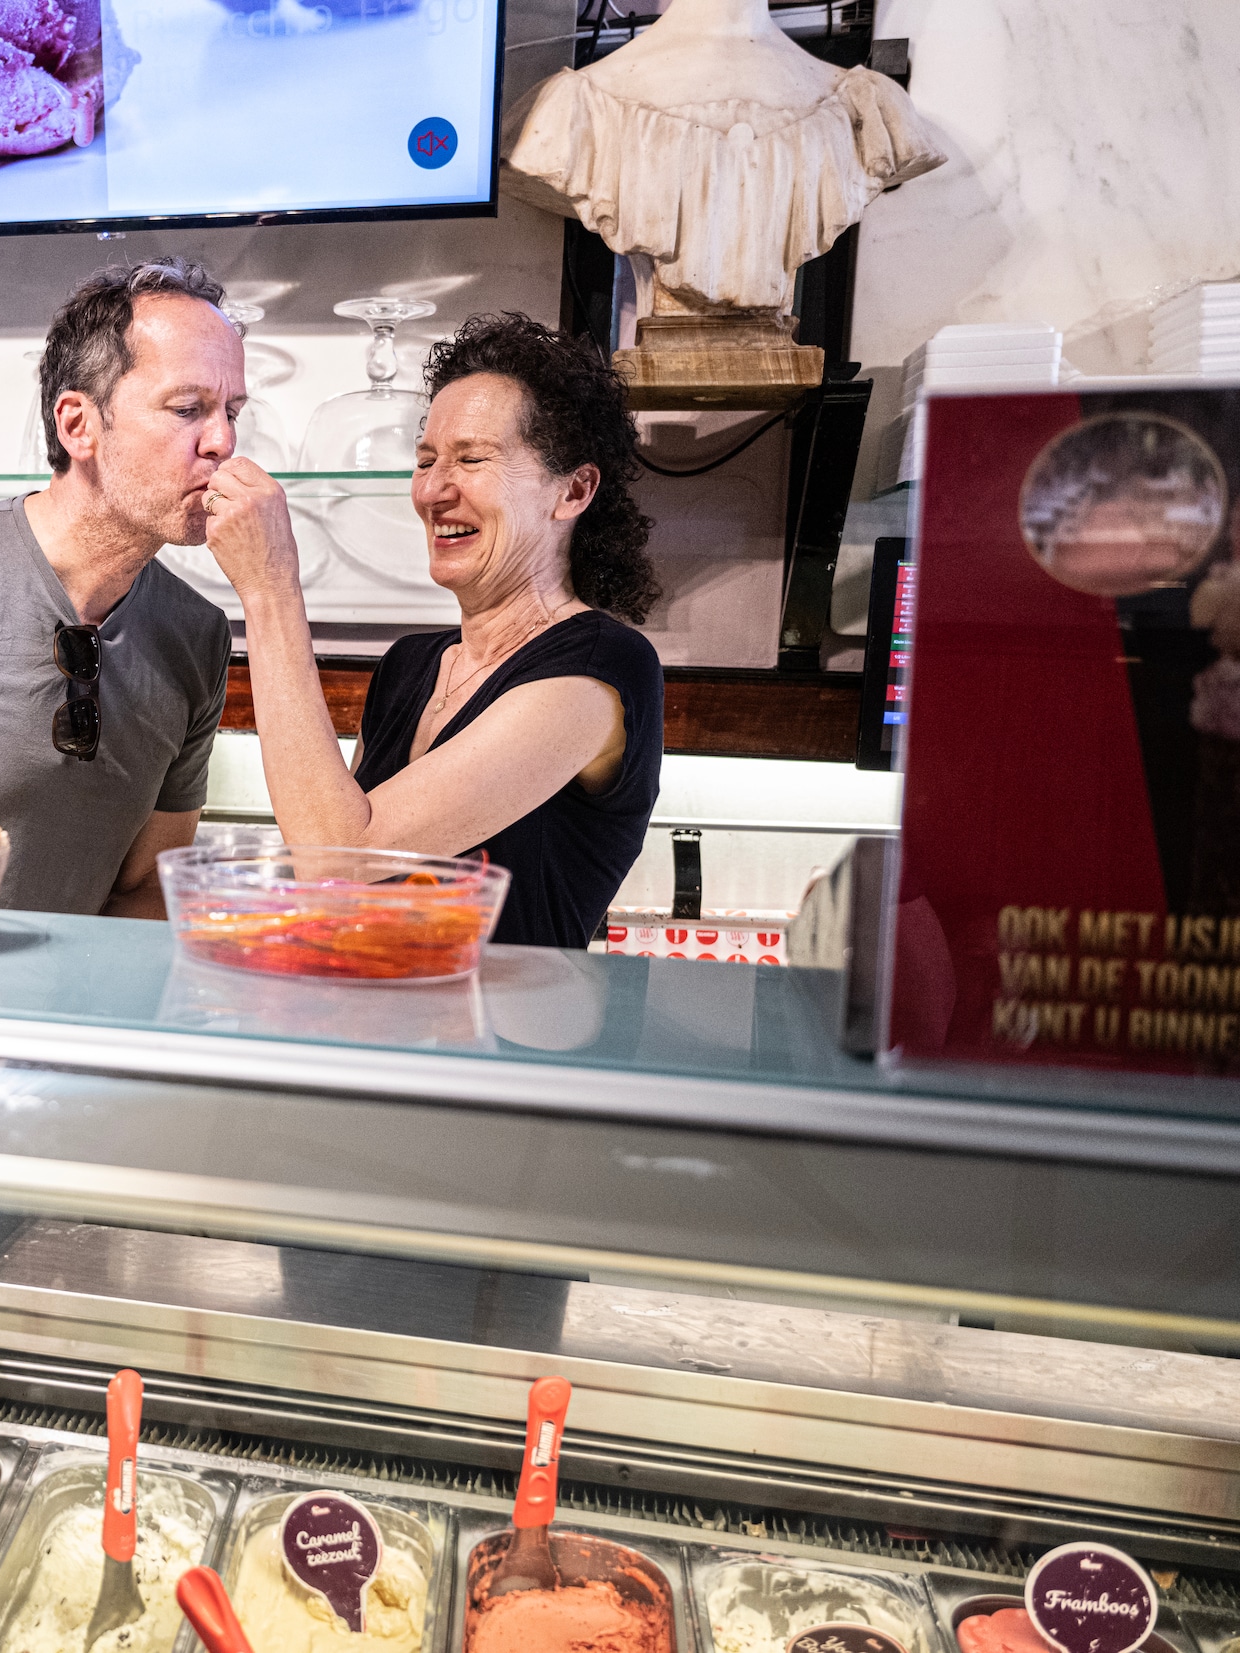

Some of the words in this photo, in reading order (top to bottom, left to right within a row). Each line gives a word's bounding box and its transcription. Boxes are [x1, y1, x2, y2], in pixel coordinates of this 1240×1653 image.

[998, 905, 1070, 948] OOK
[1078, 909, 1155, 950] MET
[997, 952, 1071, 995] VAN
[1078, 957, 1126, 998] DE
[296, 1521, 362, 1549] Caramel
[306, 1541, 363, 1567] zeezout
[1044, 1589, 1140, 1616] Framboos
